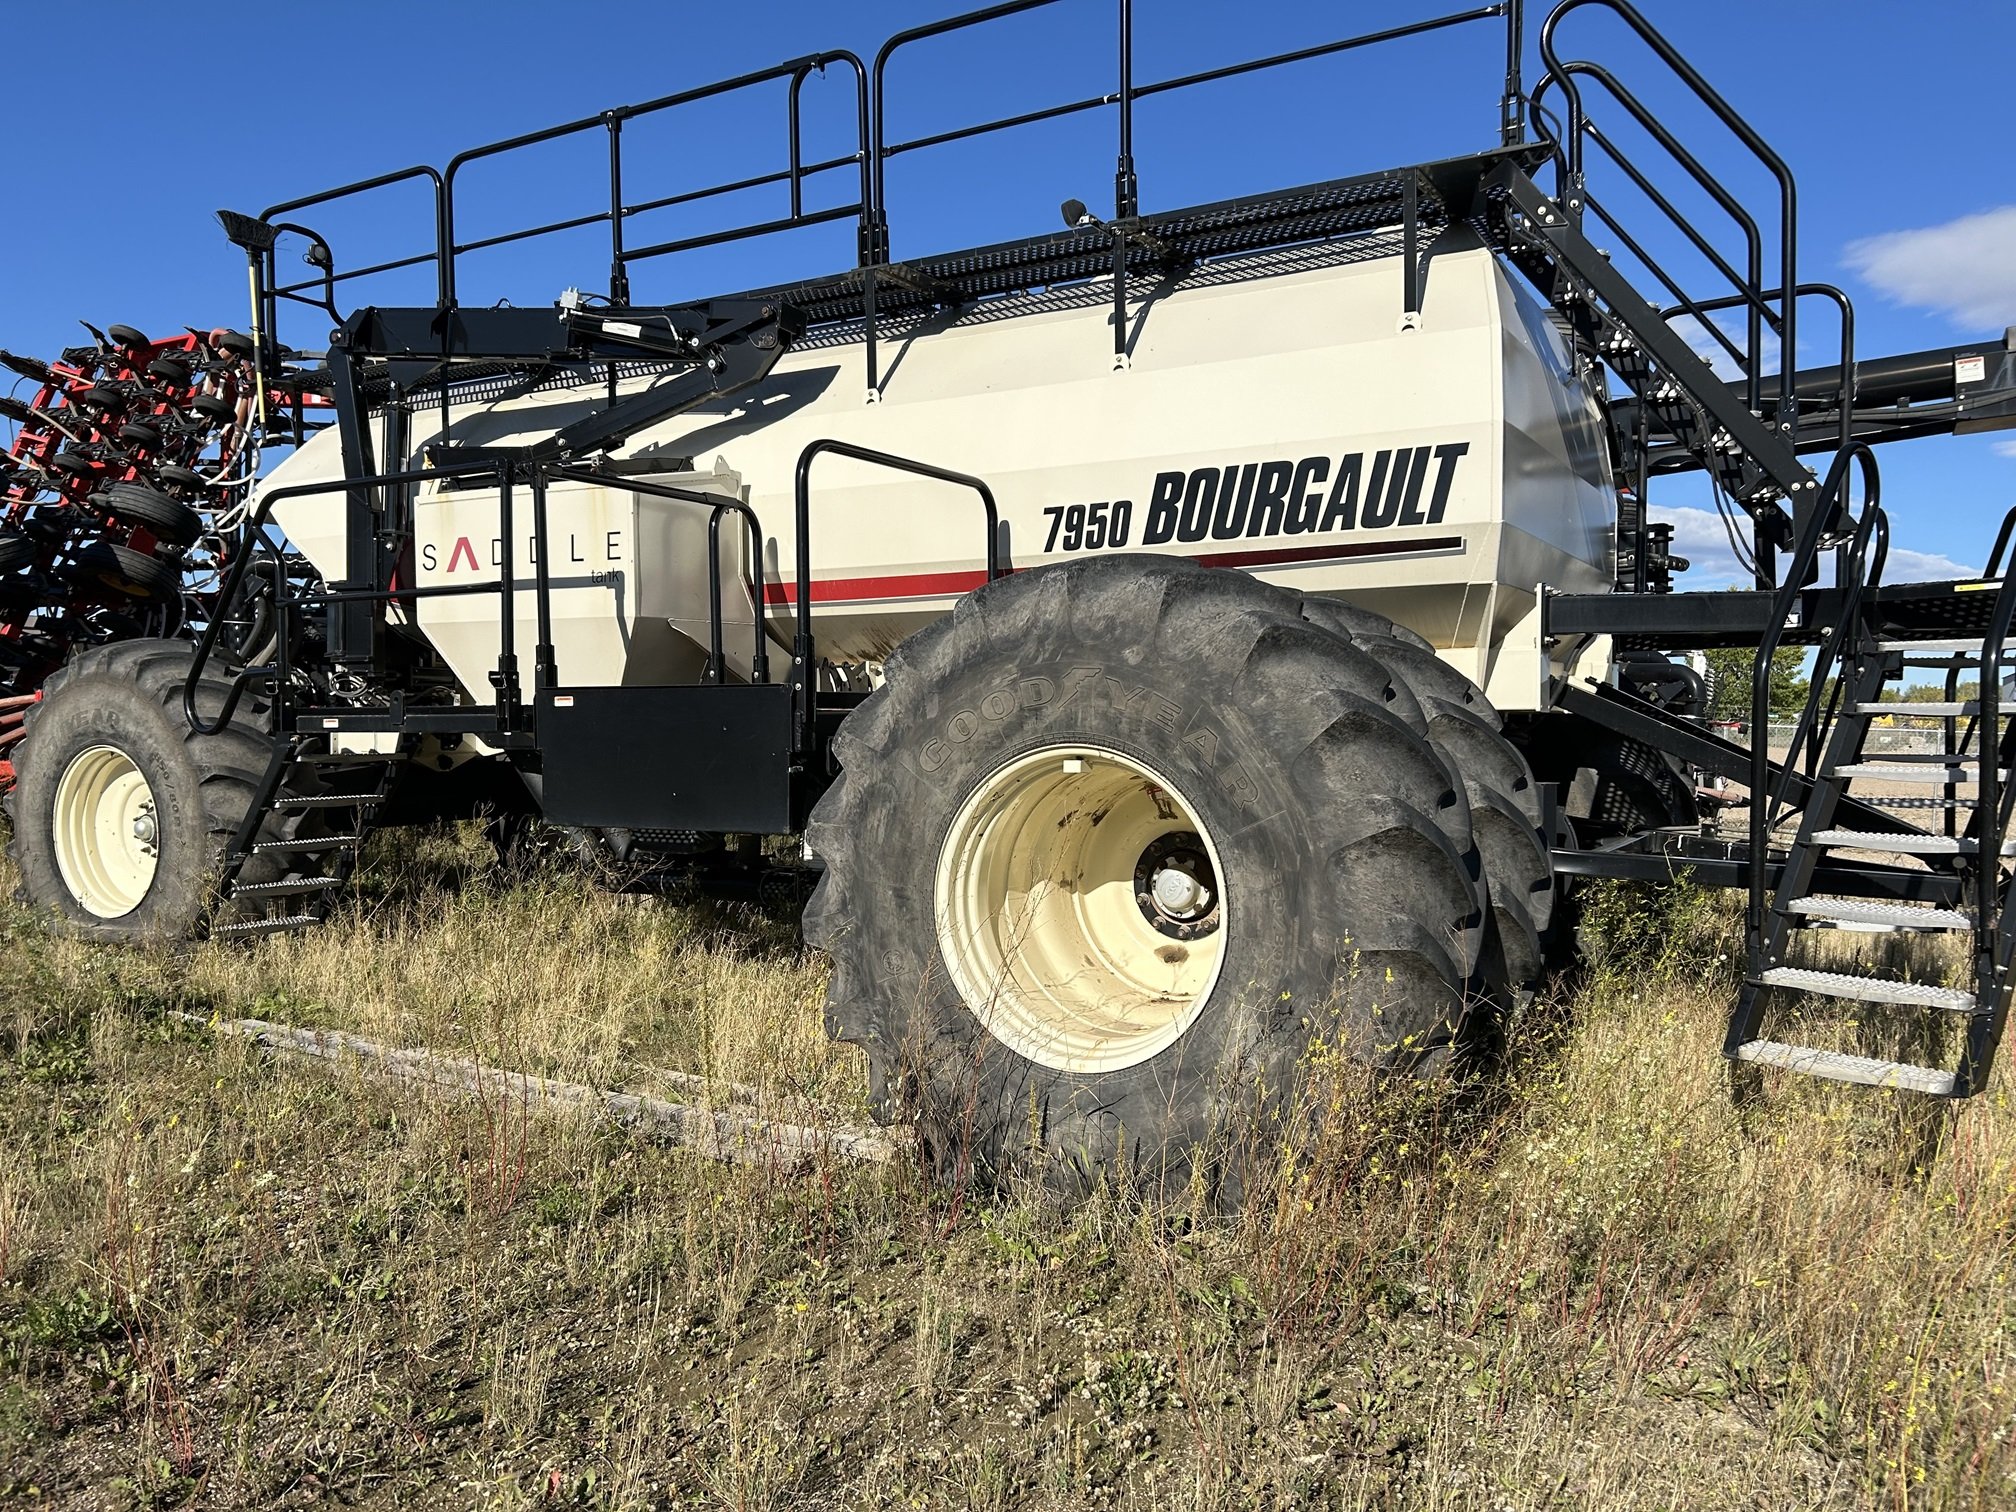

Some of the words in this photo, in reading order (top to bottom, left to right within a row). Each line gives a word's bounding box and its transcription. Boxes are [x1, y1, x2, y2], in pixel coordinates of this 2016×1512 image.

[1042, 500, 1133, 553] 7950
[1142, 441, 1470, 546] BOURGAULT
[591, 567, 620, 584] tank
[918, 667, 1260, 812] GOODYEAR
